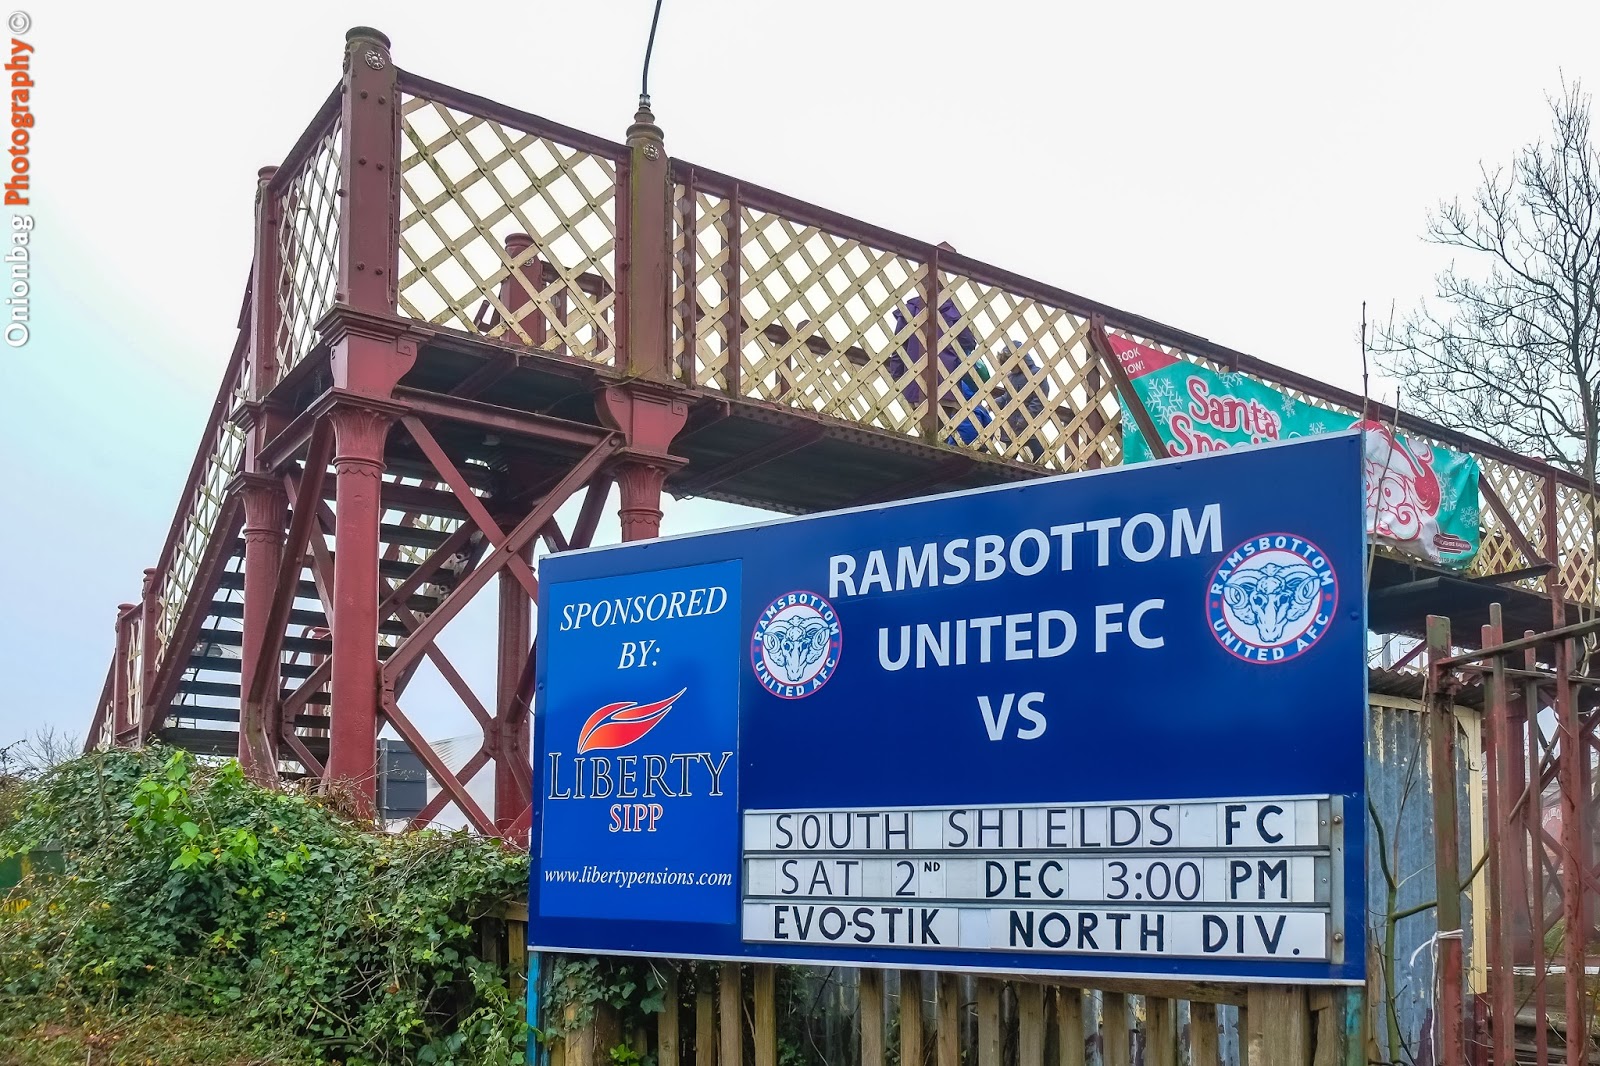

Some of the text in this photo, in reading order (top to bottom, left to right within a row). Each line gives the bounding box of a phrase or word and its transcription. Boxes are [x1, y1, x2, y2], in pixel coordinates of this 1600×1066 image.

[1187, 376, 1281, 440] Santa
[829, 503, 1223, 598] RAMSBOTTOM
[1210, 536, 1334, 594] RAMSBOTTOM
[560, 586, 727, 631] SPONSORED
[754, 594, 839, 641] RAMSBOTTOM
[618, 639, 660, 669] BY:
[878, 599, 1165, 671] UNITED FC
[1213, 613, 1329, 661] UNITED AFC
[755, 657, 835, 696] UNITED AFC
[977, 692, 1047, 741] VS
[548, 752, 733, 800] LIBERTY
[608, 803, 664, 833] SIPP
[775, 804, 1284, 849] SOUTH SHIELDS FC
[545, 865, 732, 888] www.libertypensions.com
[781, 859, 859, 895] SAT
[985, 860, 1064, 898] DEC
[1106, 861, 1201, 900] 3:00
[1230, 859, 1288, 900] PM
[1009, 911, 1165, 952] NORTH
[1202, 915, 1300, 955] DIV.
